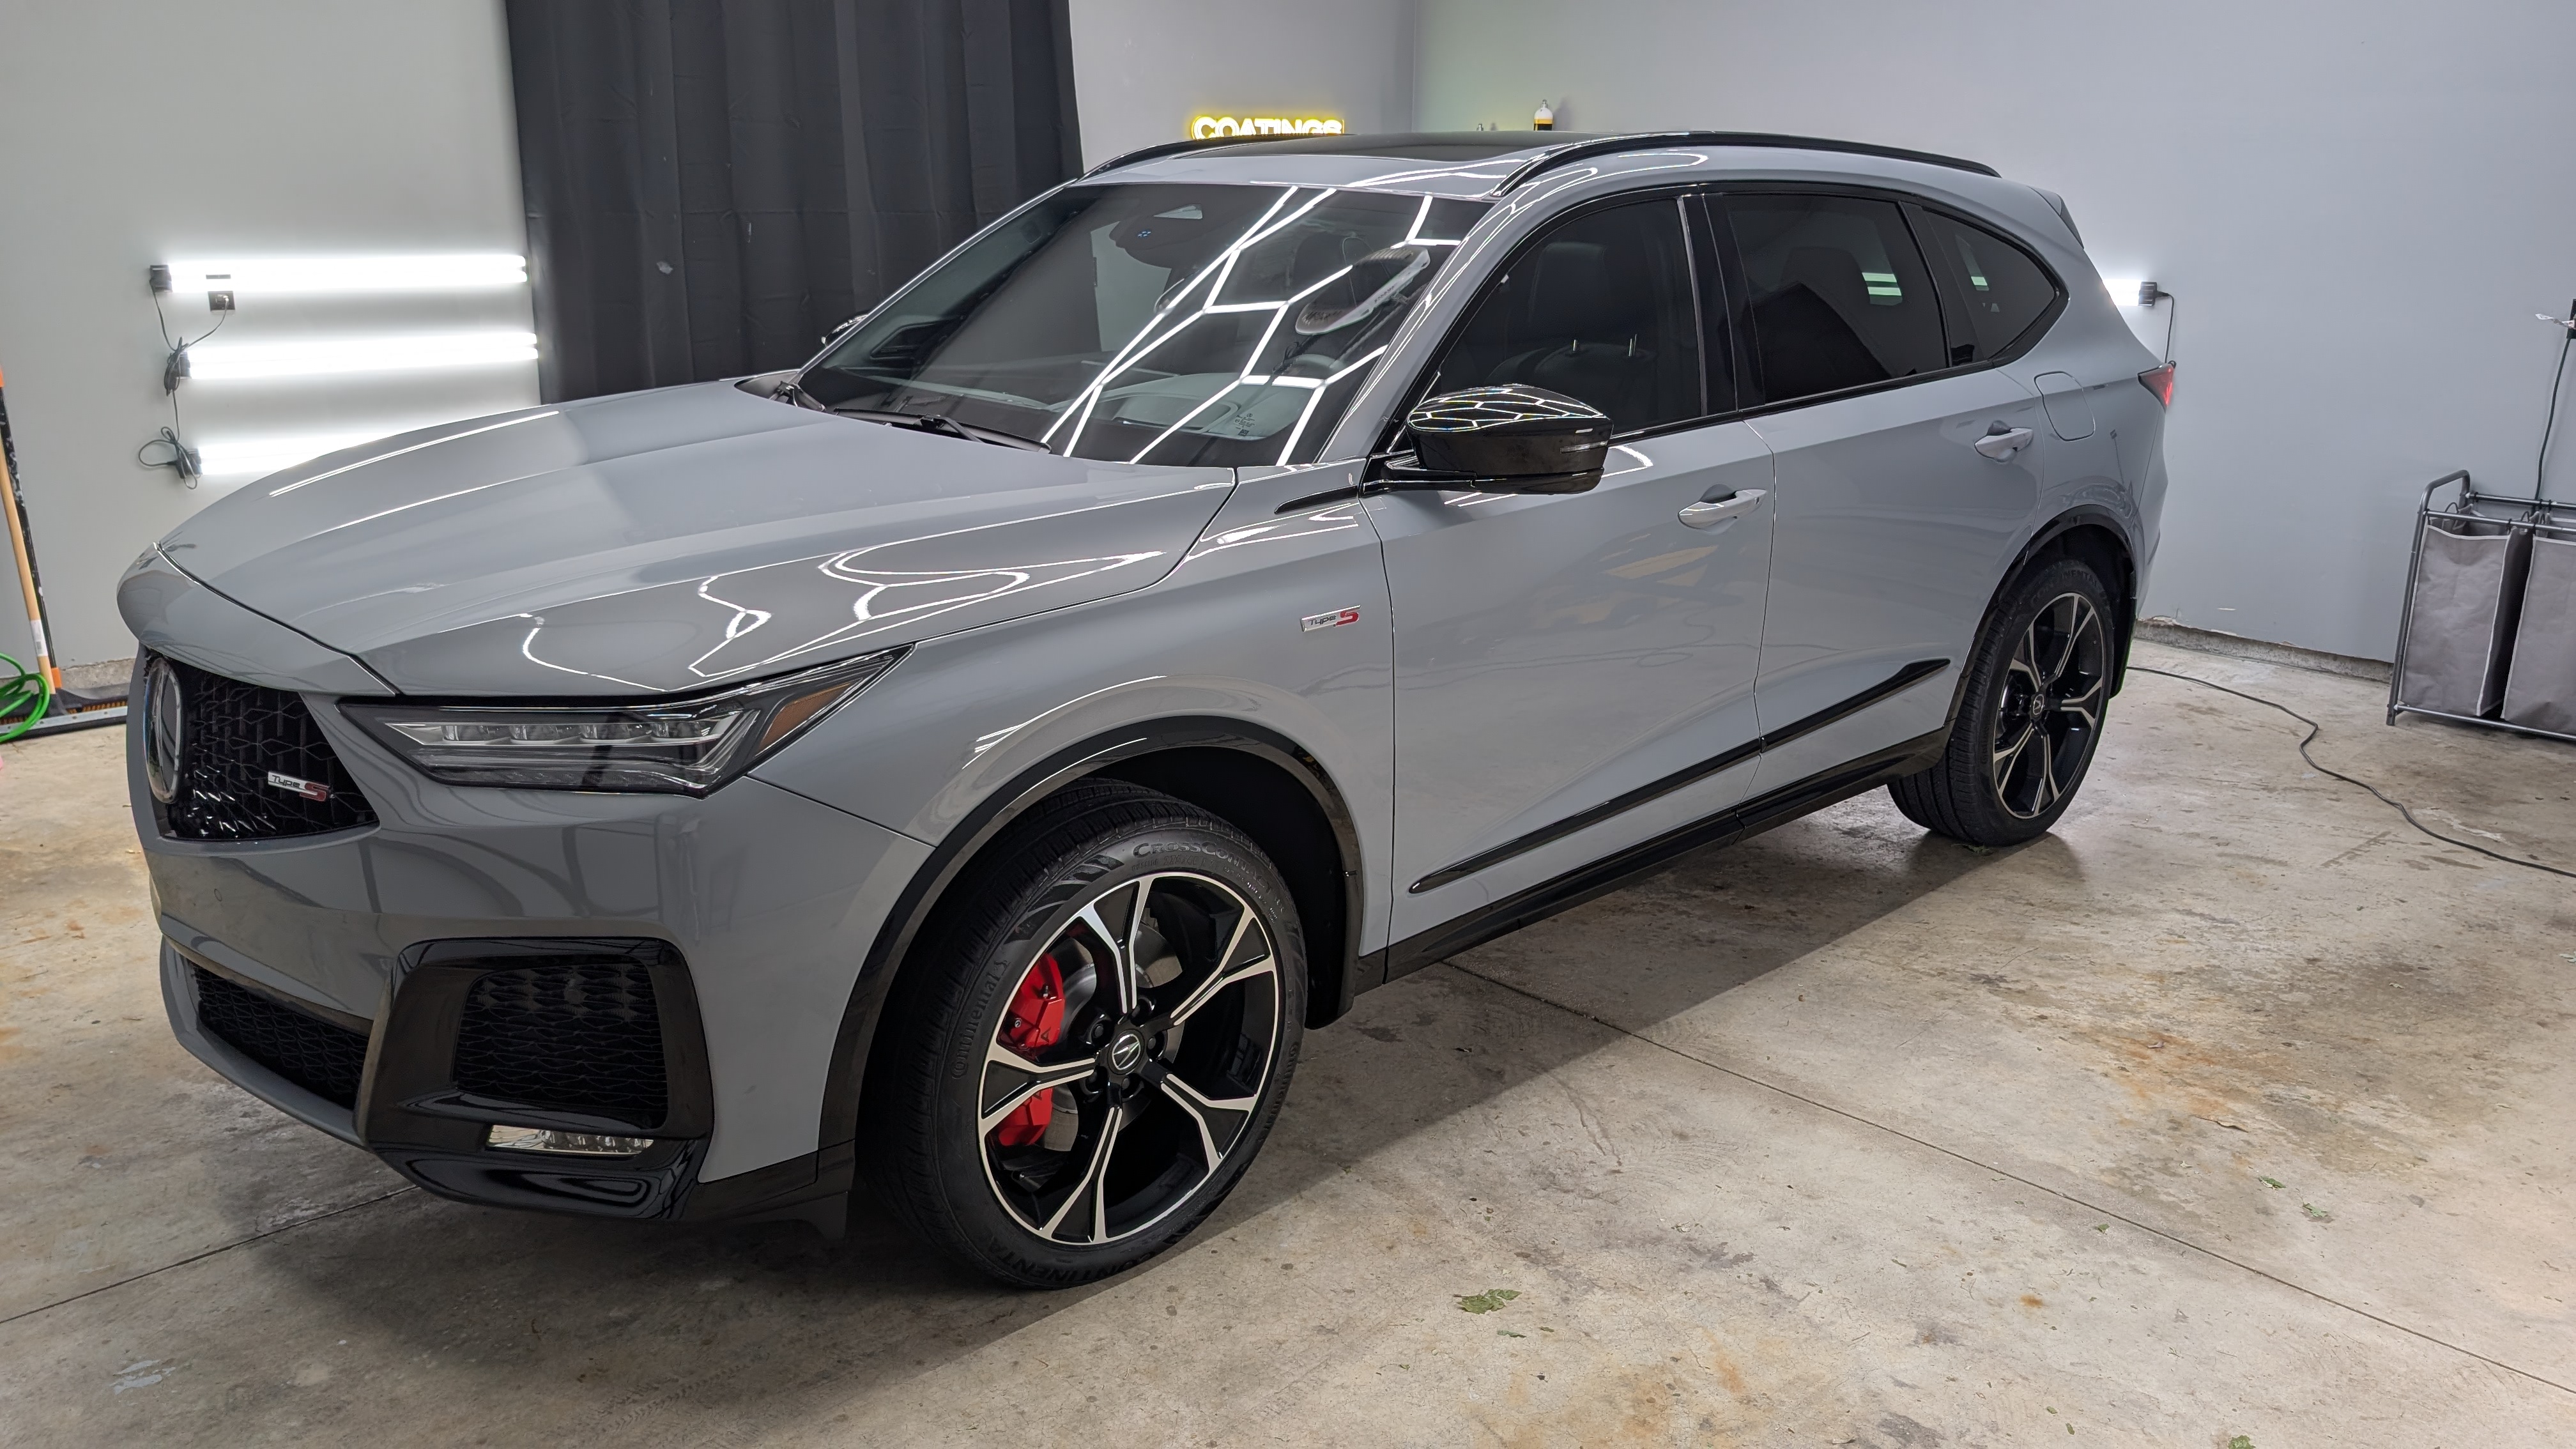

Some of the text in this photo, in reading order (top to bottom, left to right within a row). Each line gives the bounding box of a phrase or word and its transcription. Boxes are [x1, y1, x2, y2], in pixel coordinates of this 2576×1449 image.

[1193, 116, 1343, 139] COATINGS
[1309, 611, 1359, 627] Type S
[272, 775, 326, 802] Type S
[950, 972, 1000, 1080] Continental
